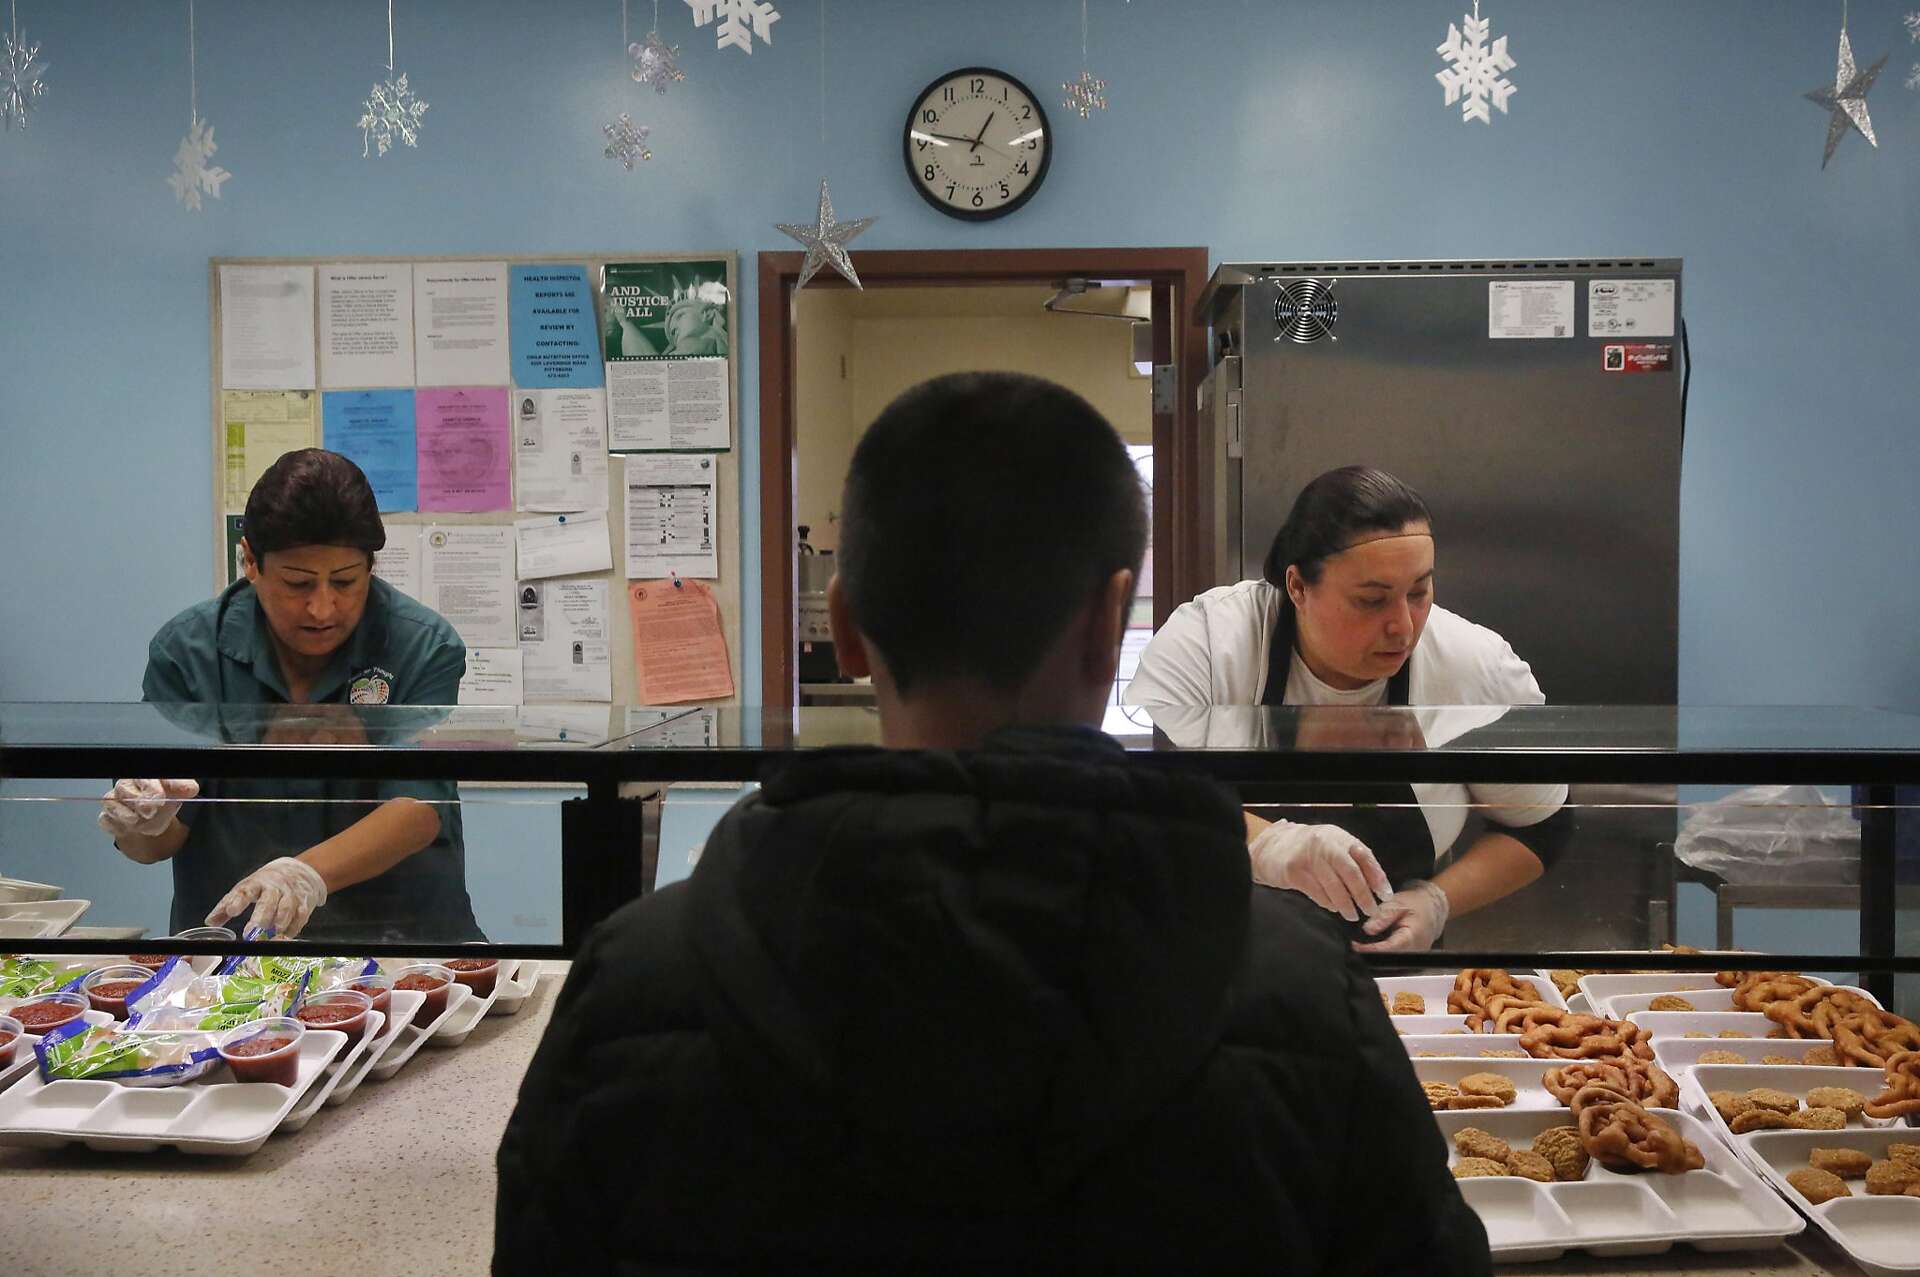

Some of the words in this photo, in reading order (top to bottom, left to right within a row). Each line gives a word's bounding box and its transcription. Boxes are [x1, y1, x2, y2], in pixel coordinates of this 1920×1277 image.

[970, 79, 985, 94] 12
[1003, 87, 1009, 101] 1
[944, 87, 954, 102] 11
[922, 109, 937, 124] 10
[1021, 105, 1032, 120] 2
[916, 137, 928, 152] 9
[1027, 137, 1038, 151] 3
[924, 164, 936, 181] 8
[1017, 161, 1030, 177] 4
[946, 186, 956, 200] 7
[1000, 184, 1010, 199] 5
[971, 192, 984, 207] 6
[611, 286, 640, 296] AND
[612, 296, 669, 306] JUSTICE
[627, 307, 653, 317] ALL
